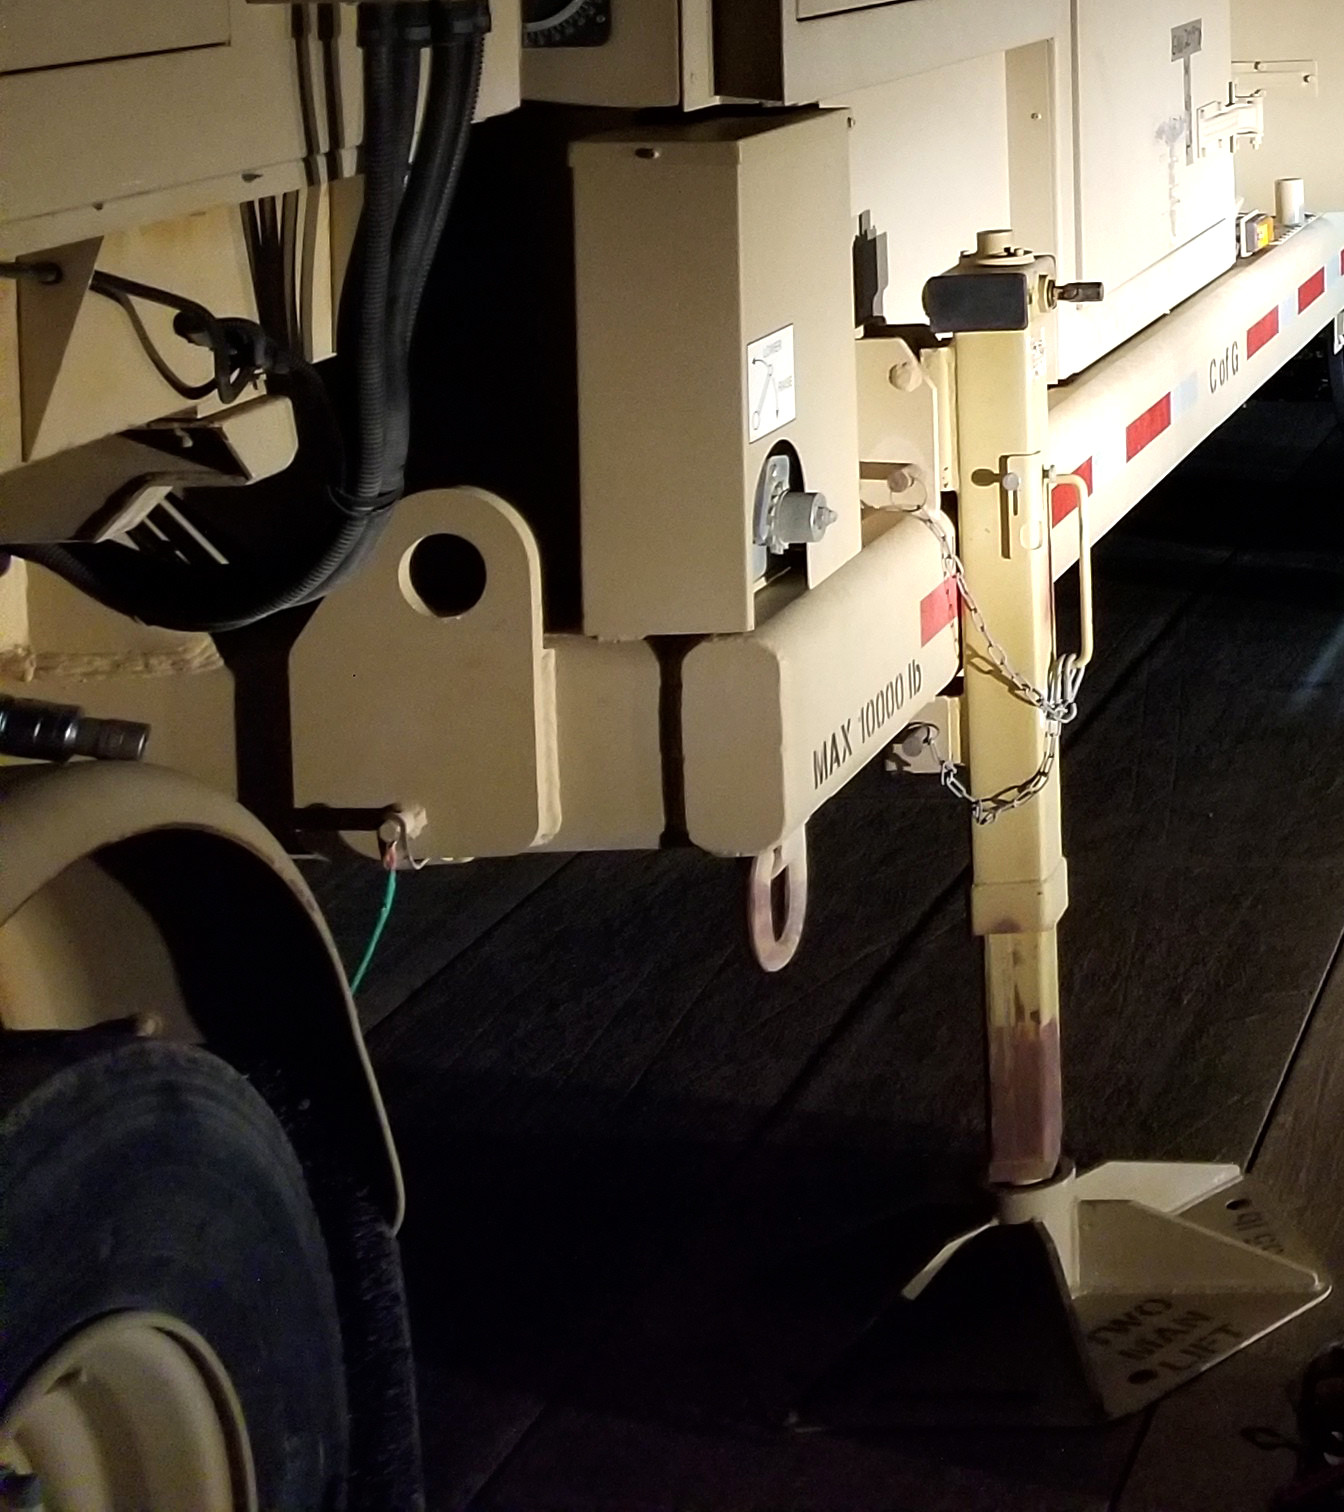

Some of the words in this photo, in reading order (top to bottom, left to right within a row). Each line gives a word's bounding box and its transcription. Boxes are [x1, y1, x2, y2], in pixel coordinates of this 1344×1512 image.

[1209, 358, 1217, 394] C
[1219, 347, 1229, 386] of
[1231, 340, 1239, 376] G
[812, 718, 852, 789] MAX
[858, 673, 904, 744] 10000
[908, 659, 922, 700] lb
[1087, 1299, 1173, 1346] TWO
[1158, 1323, 1243, 1371] LIFT
